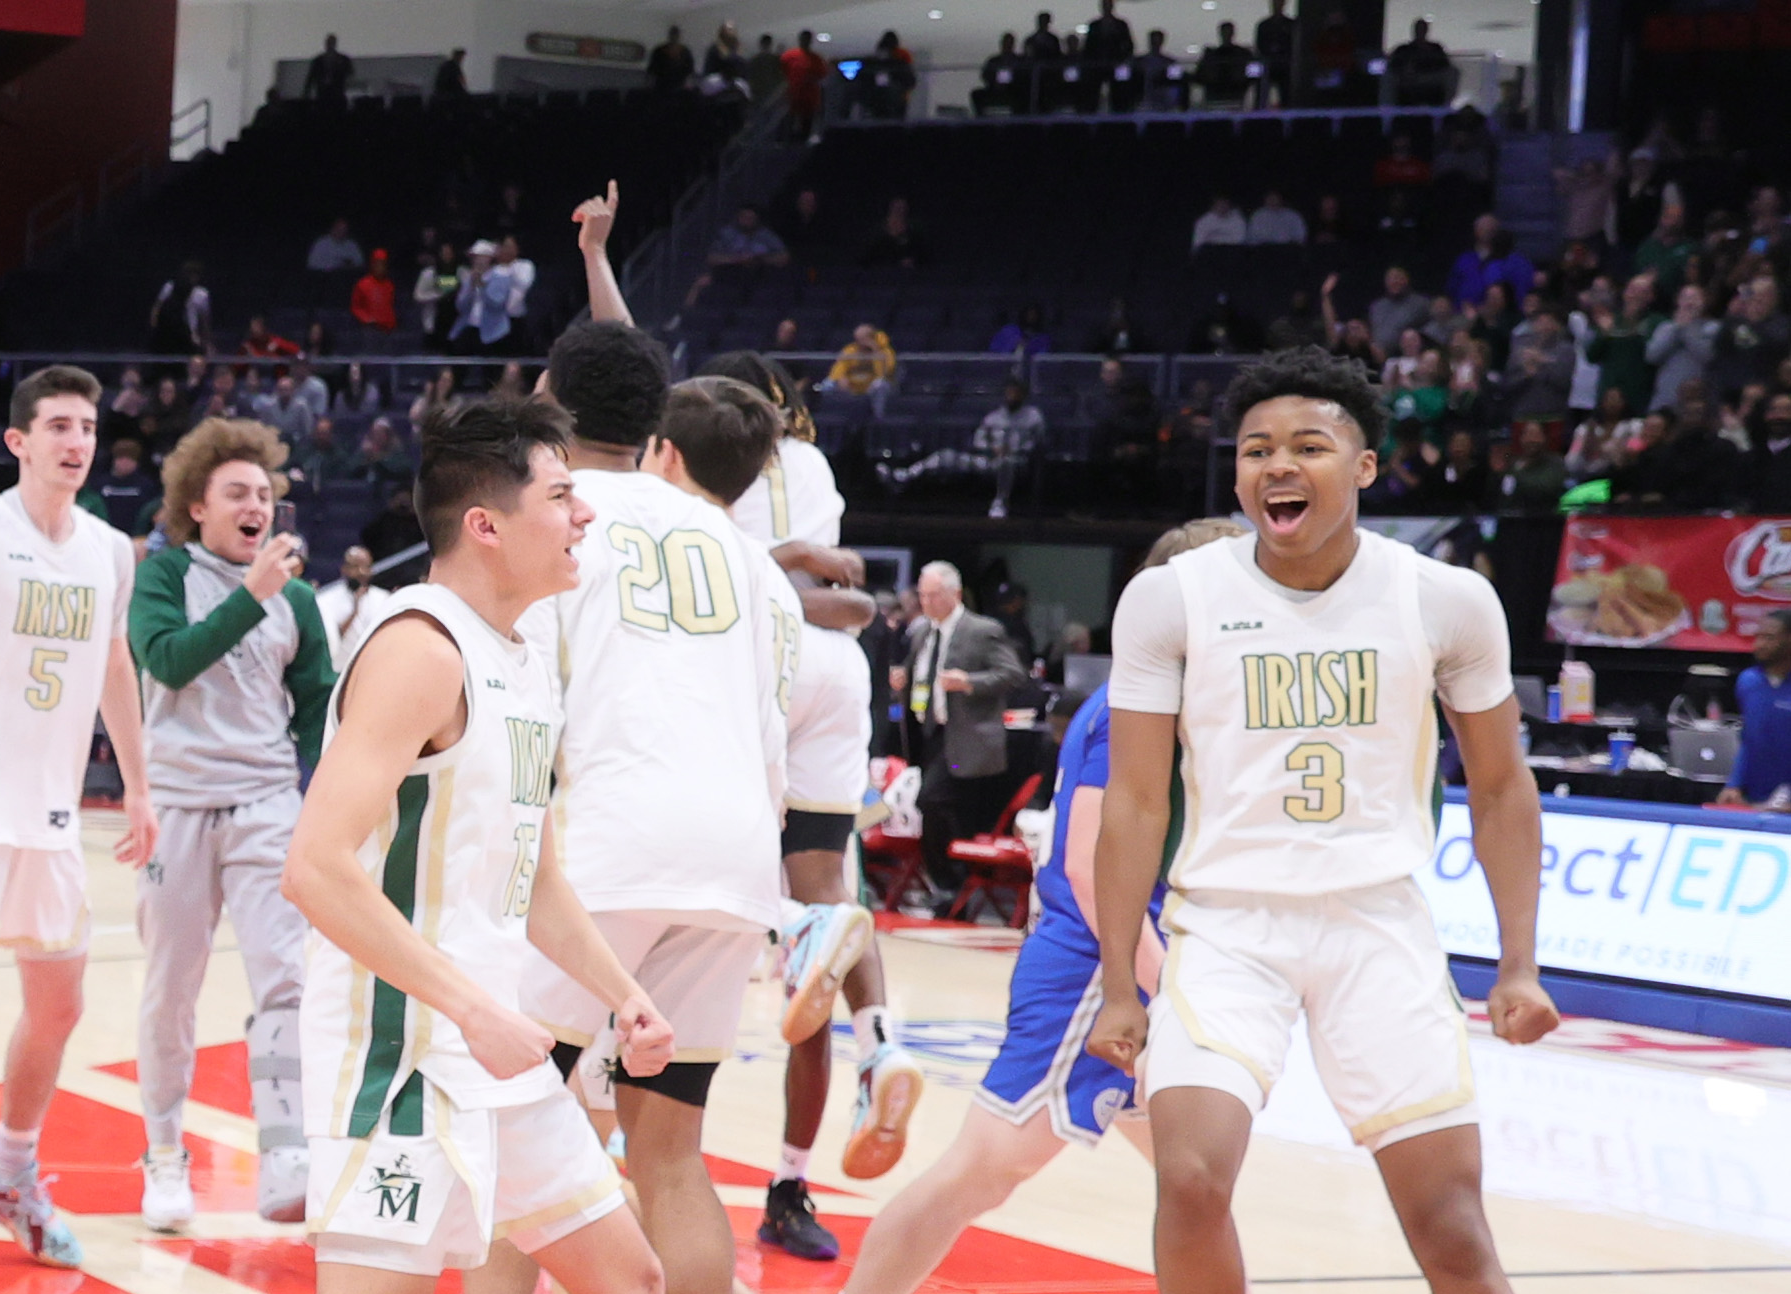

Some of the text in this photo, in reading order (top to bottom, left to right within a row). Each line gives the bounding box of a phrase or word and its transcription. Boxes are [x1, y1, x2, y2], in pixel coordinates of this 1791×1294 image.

[13, 578, 96, 641] IRISH
[606, 520, 741, 635] 20
[25, 647, 68, 711] 5
[1242, 649, 1377, 730] IRISH
[1283, 742, 1345, 822] 3
